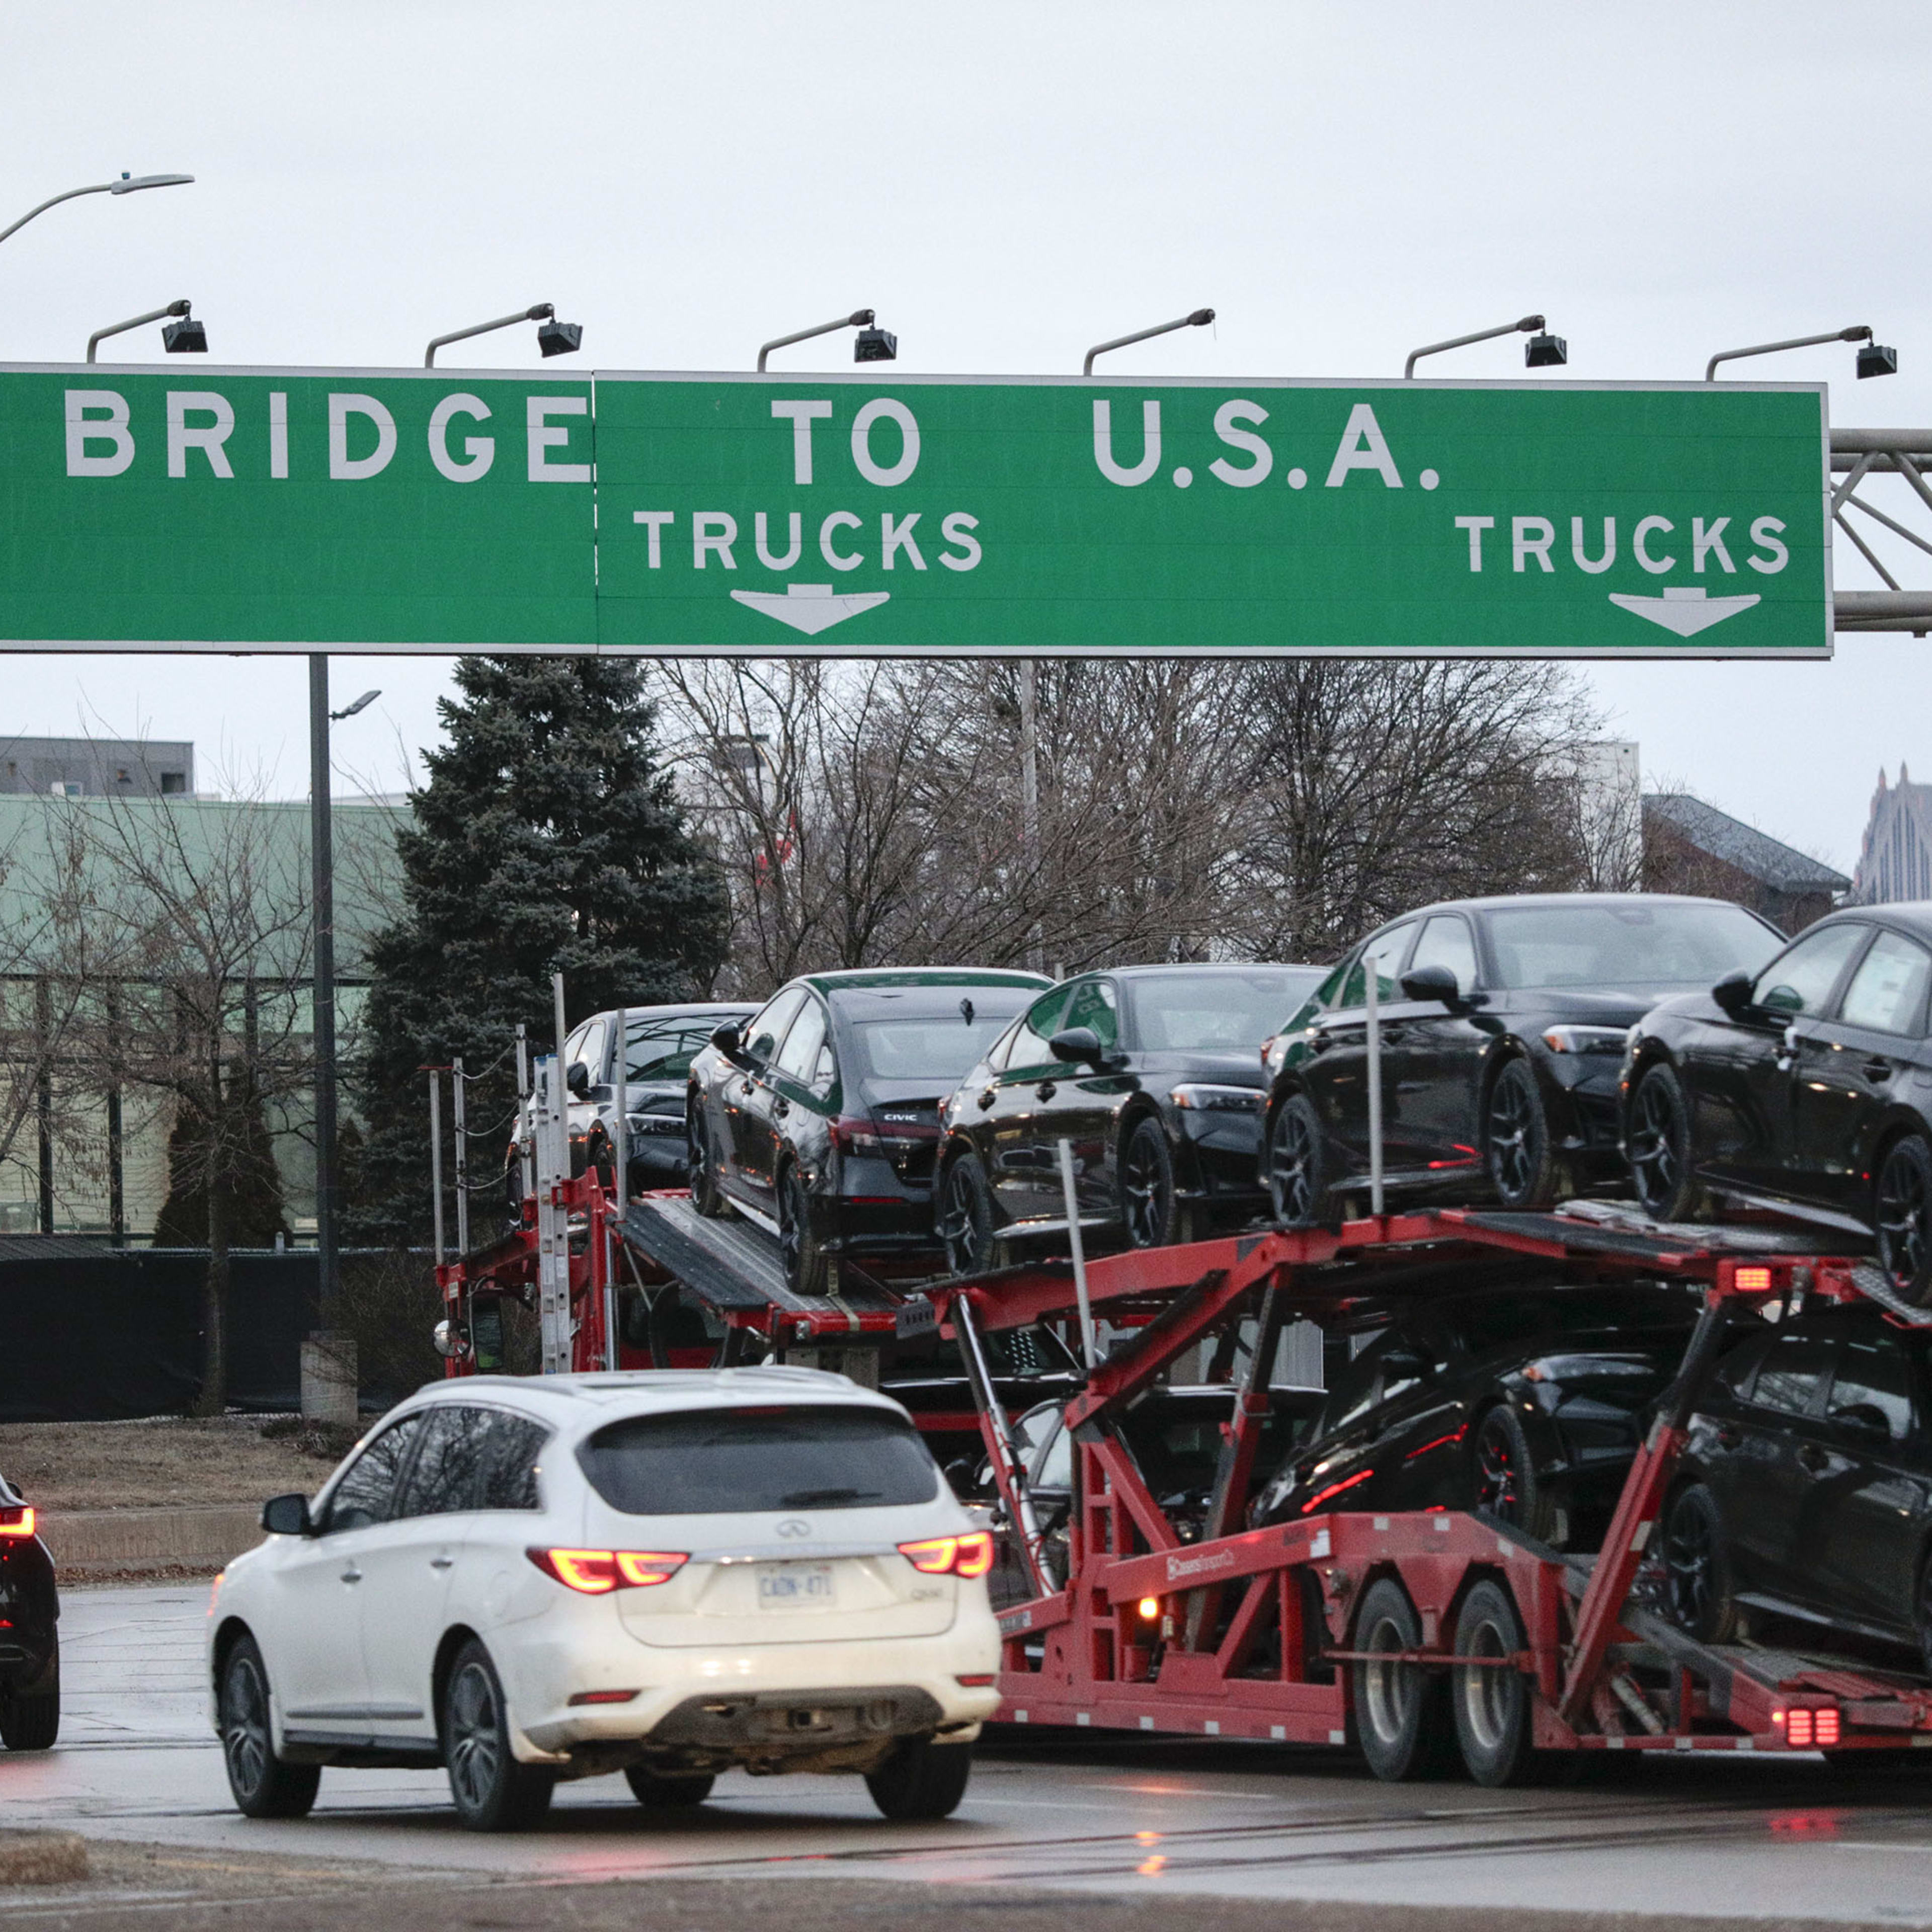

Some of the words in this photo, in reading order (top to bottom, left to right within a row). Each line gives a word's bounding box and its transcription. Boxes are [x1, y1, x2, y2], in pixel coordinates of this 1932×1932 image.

[65, 389, 591, 483] BRIDGE
[771, 398, 921, 487] TO
[1093, 398, 1440, 491] U.S.A.
[633, 511, 983, 572] TRUCKS
[1455, 515, 1789, 575] TRUCKS
